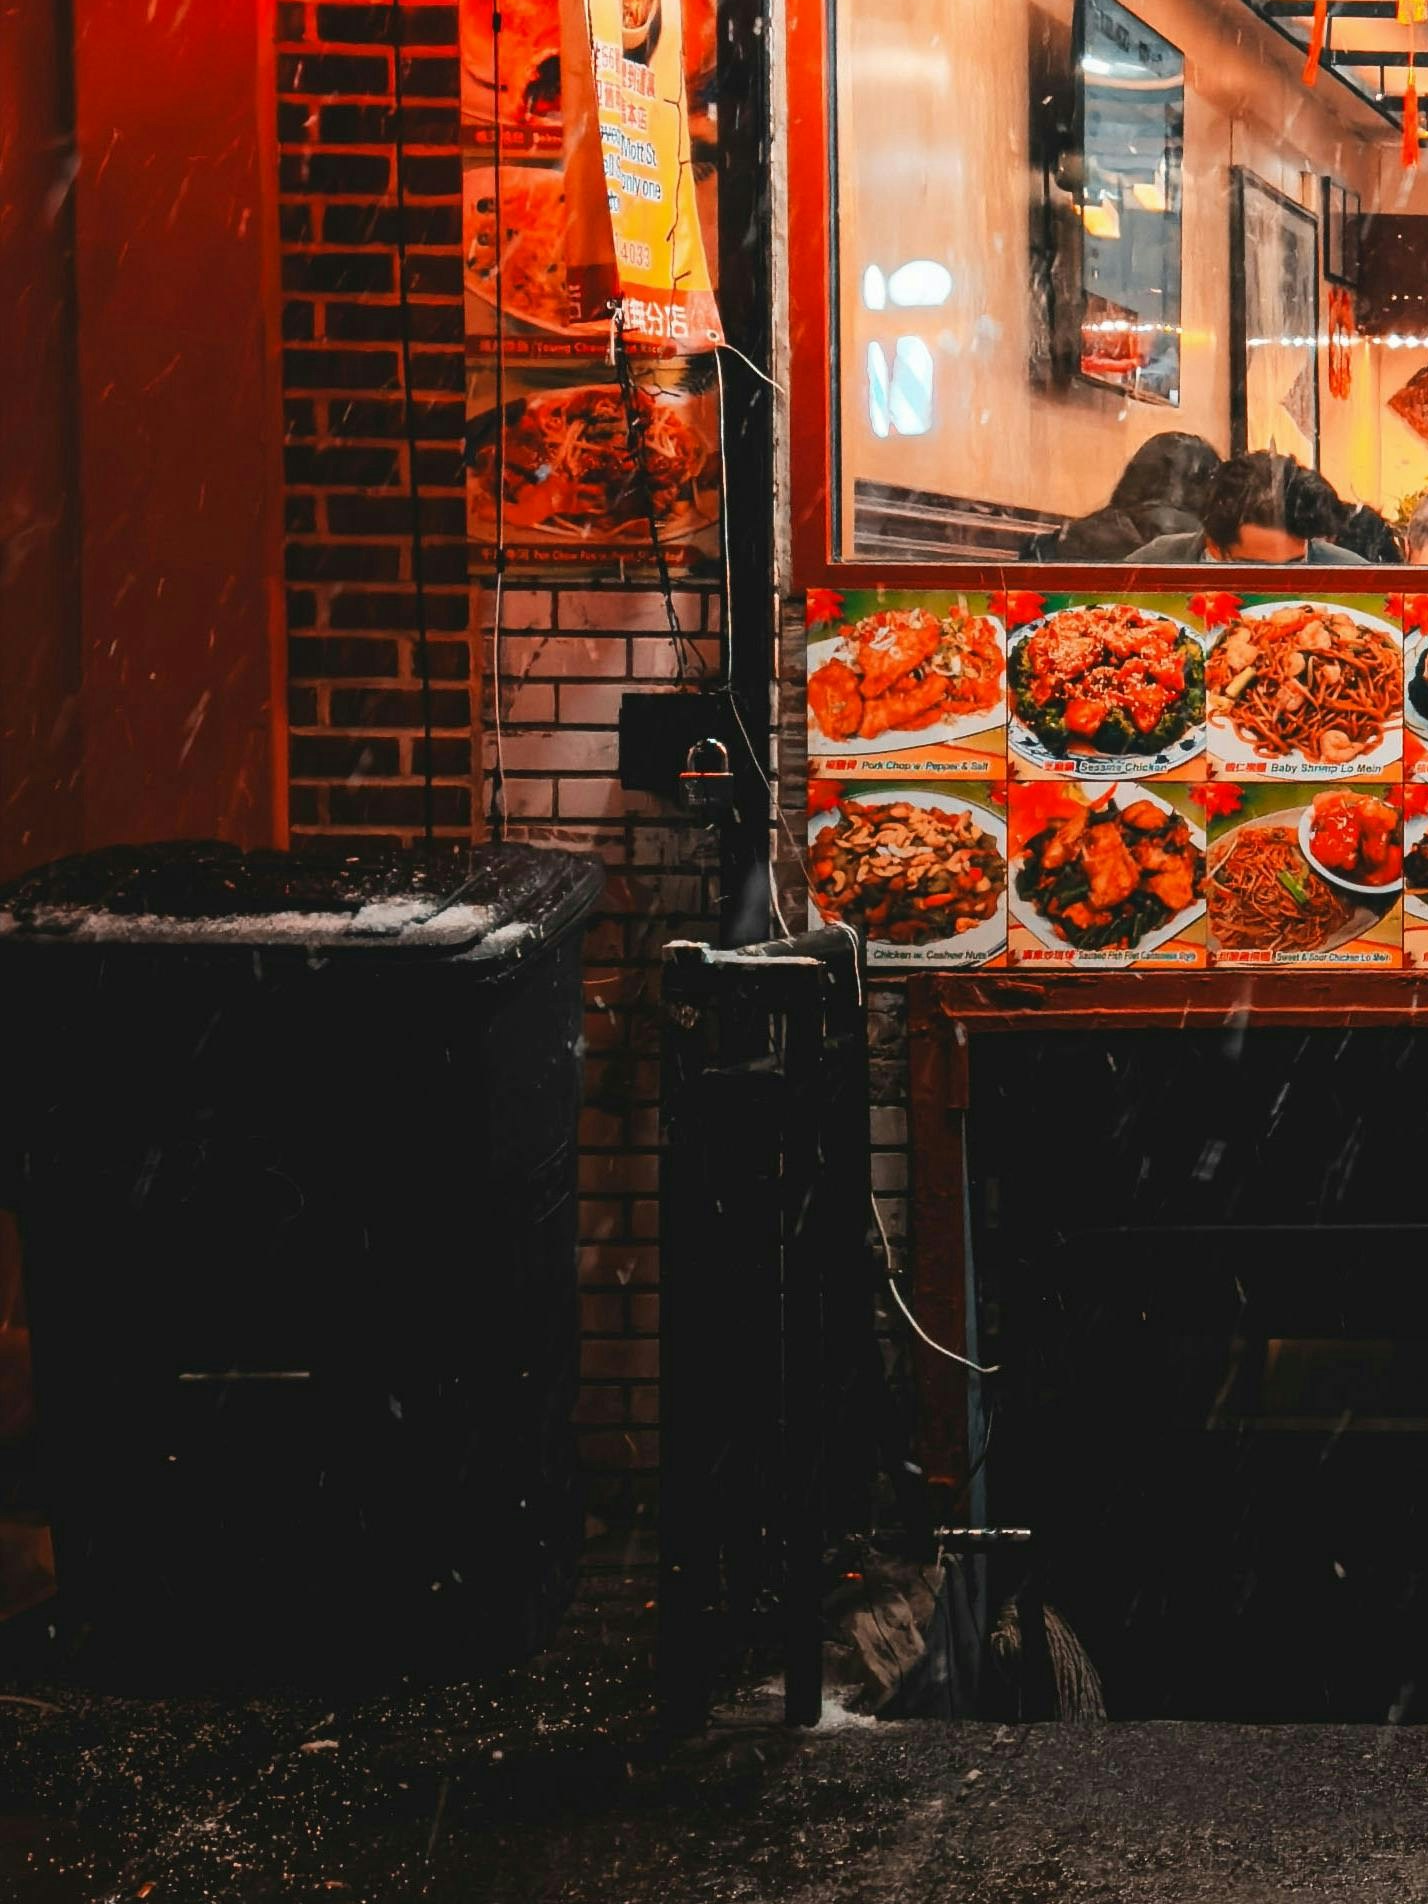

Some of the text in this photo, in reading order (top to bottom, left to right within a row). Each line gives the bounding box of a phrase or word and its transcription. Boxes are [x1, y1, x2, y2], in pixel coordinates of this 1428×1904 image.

[886, 761, 911, 771] Chop
[926, 762, 957, 772] Pepper
[1081, 762, 1167, 771] Sesame Chicken
[1271, 764, 1381, 773] Baby Shrimp Lo Mein
[874, 950, 911, 959] Chicken
[1277, 952, 1300, 961] Sweet
[1329, 952, 1359, 961] Chicken
